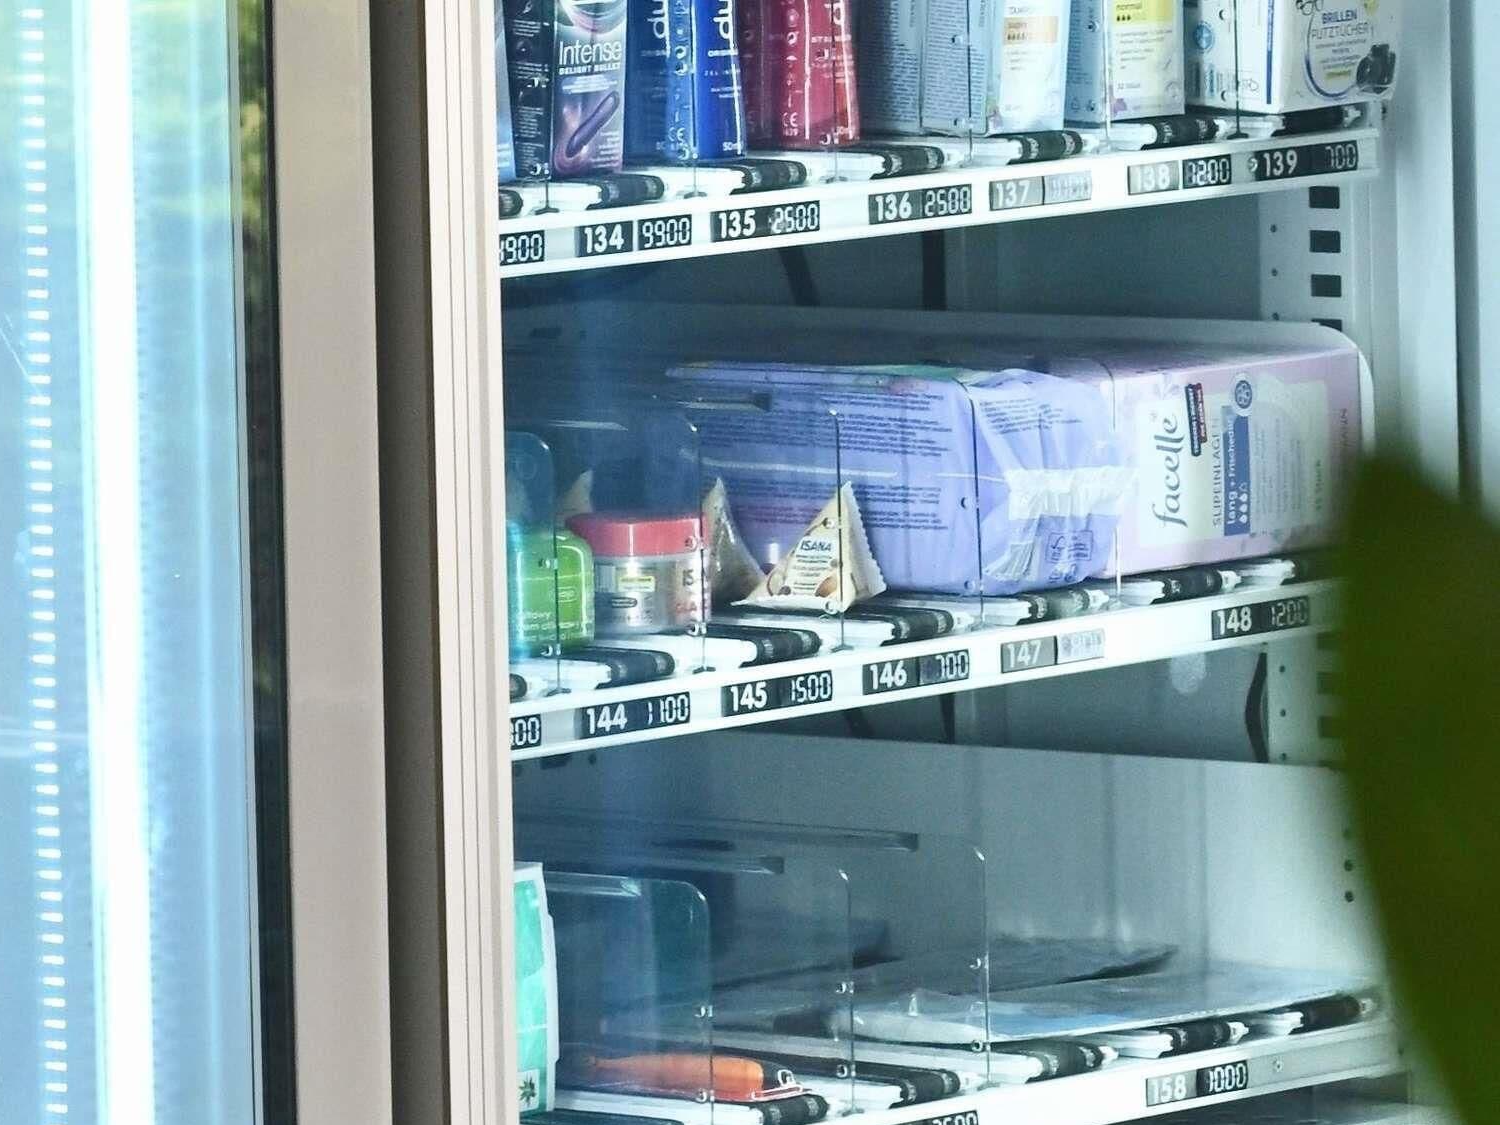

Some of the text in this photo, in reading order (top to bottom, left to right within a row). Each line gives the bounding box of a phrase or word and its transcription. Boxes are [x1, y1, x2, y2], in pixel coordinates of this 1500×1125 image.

[1322, 9, 1358, 25] BRILLEN
[559, 40, 623, 65] Intense
[1136, 163, 1170, 192] 138
[1263, 149, 1298, 177] 139
[875, 191, 913, 222] 136
[995, 179, 1029, 208] 137
[583, 224, 625, 254] 134
[717, 210, 756, 239] 135
[1152, 411, 1188, 530] facelle
[800, 540, 832, 552] ISANA
[1216, 606, 1252, 633] 148
[1006, 639, 1041, 668] 147
[870, 660, 908, 690] 146
[729, 684, 768, 713] 145
[587, 705, 628, 735] 144
[1152, 1076, 1188, 1102] 158
